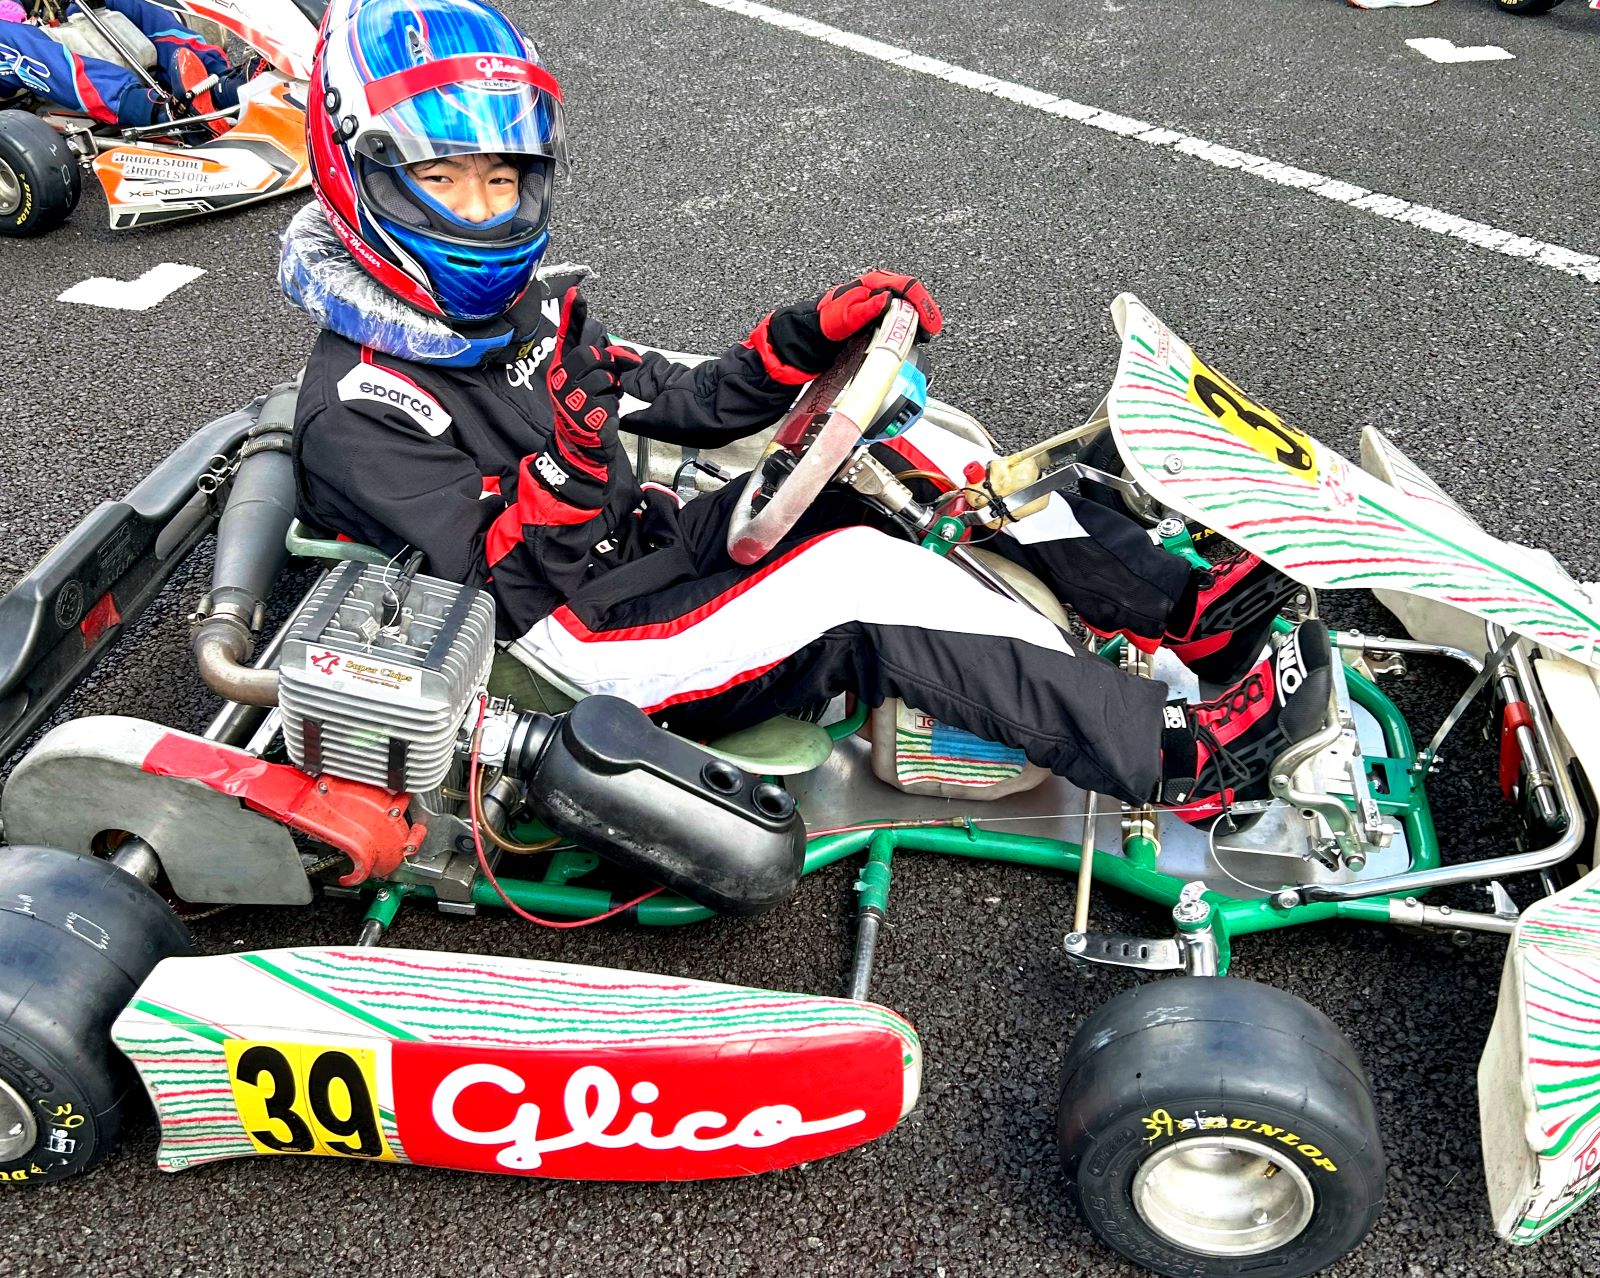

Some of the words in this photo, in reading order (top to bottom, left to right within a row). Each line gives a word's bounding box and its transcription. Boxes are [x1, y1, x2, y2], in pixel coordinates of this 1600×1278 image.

[475, 57, 526, 78] Glico
[114, 154, 199, 170] BRIDGESTONE
[125, 165, 210, 183] BRIDGESTONE
[16, 182, 33, 226] DUNLOP
[888, 316, 908, 344] TONY
[506, 336, 557, 391] Glico
[359, 381, 433, 419] sparco
[1194, 352, 1312, 470] 3
[535, 454, 567, 488] OMP
[236, 1045, 383, 1157] 39
[431, 1062, 867, 1170] Glico
[1141, 1108, 1174, 1141] 39
